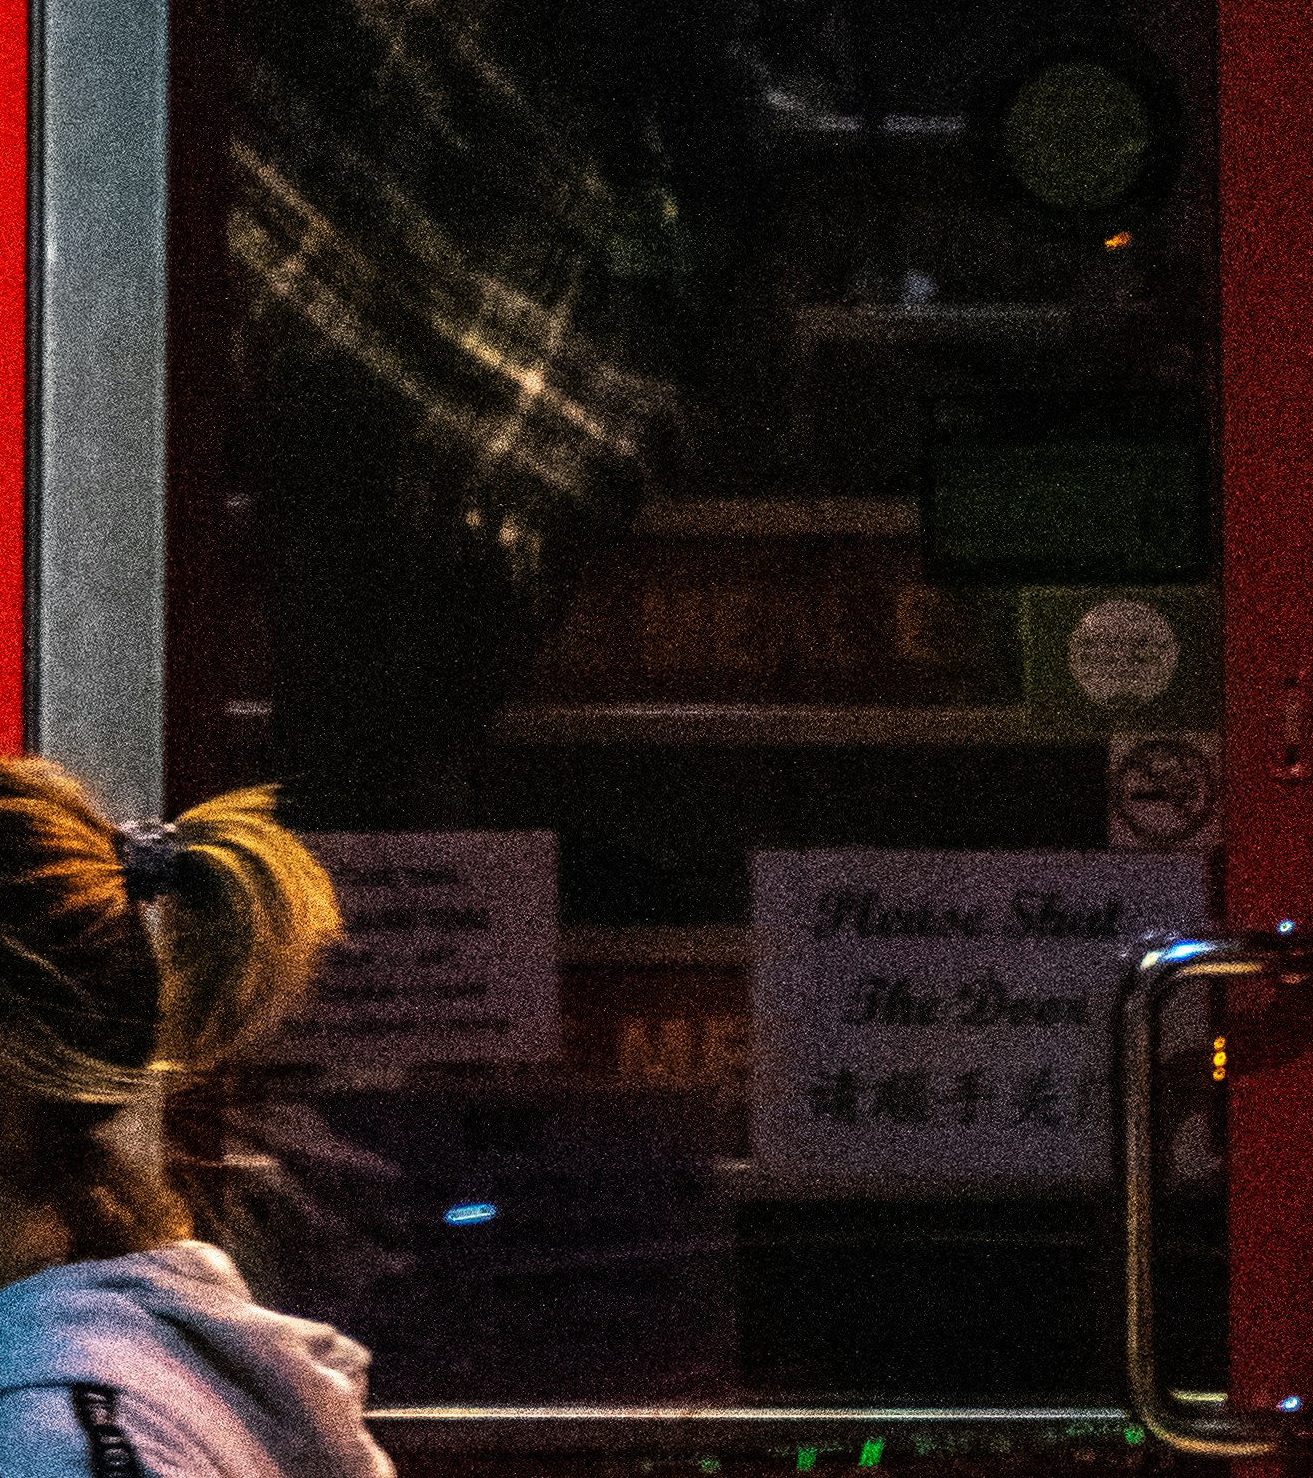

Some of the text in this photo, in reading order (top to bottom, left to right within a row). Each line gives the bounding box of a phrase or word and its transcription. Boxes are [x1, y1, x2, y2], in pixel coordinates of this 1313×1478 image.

[813, 888, 1122, 939] Please Shut
[845, 974, 939, 1025] The
